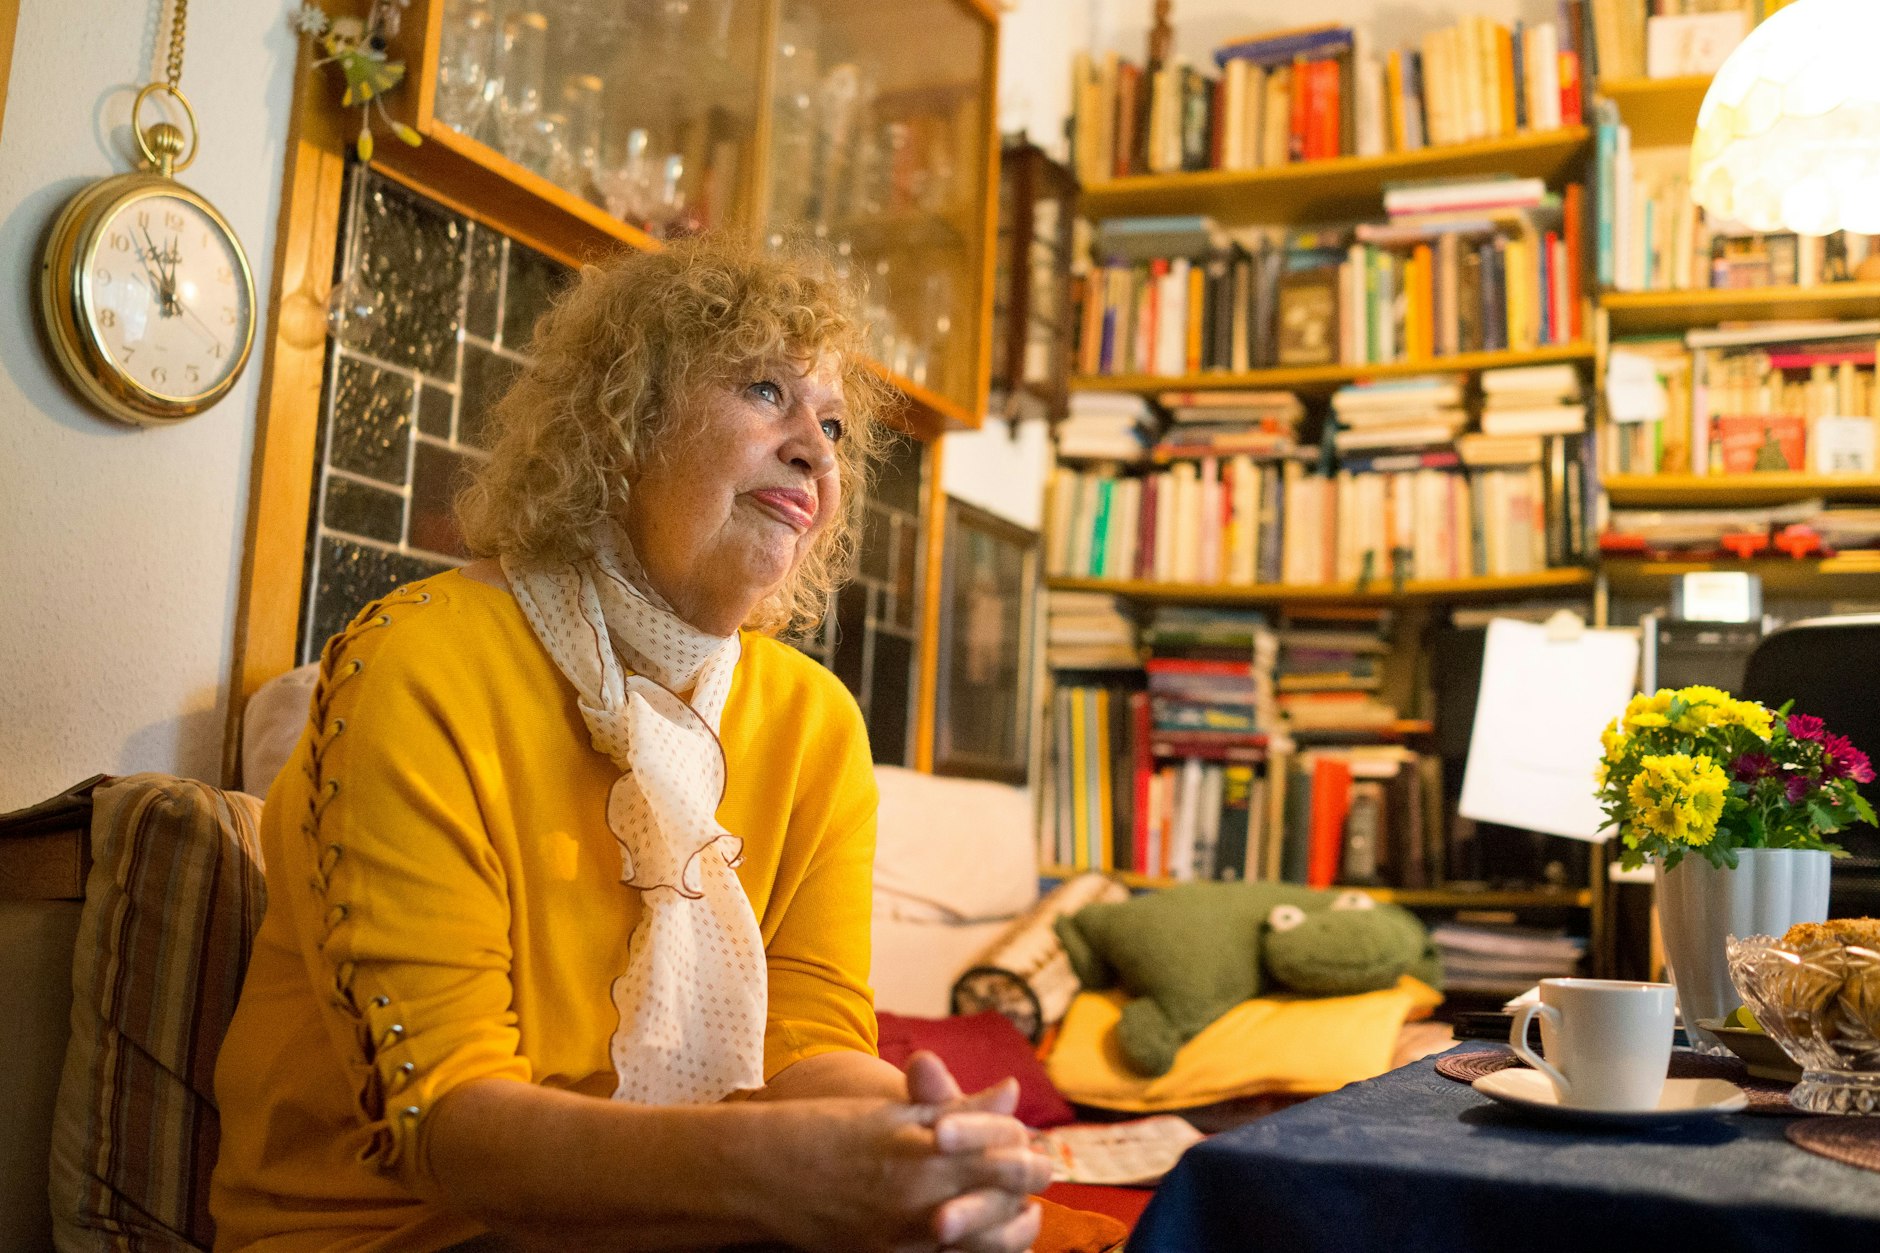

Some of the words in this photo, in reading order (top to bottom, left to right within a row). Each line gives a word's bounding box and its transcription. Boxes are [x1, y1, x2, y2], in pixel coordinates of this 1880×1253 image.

[138, 211, 150, 230] 11
[165, 211, 184, 232] 12
[110, 231, 131, 252] 10
[97, 267, 112, 287] 9
[101, 308, 115, 328] 8
[122, 345, 135, 363] 7
[206, 341, 221, 358] 4
[151, 366, 167, 384] 6
[185, 364, 199, 382] 5
